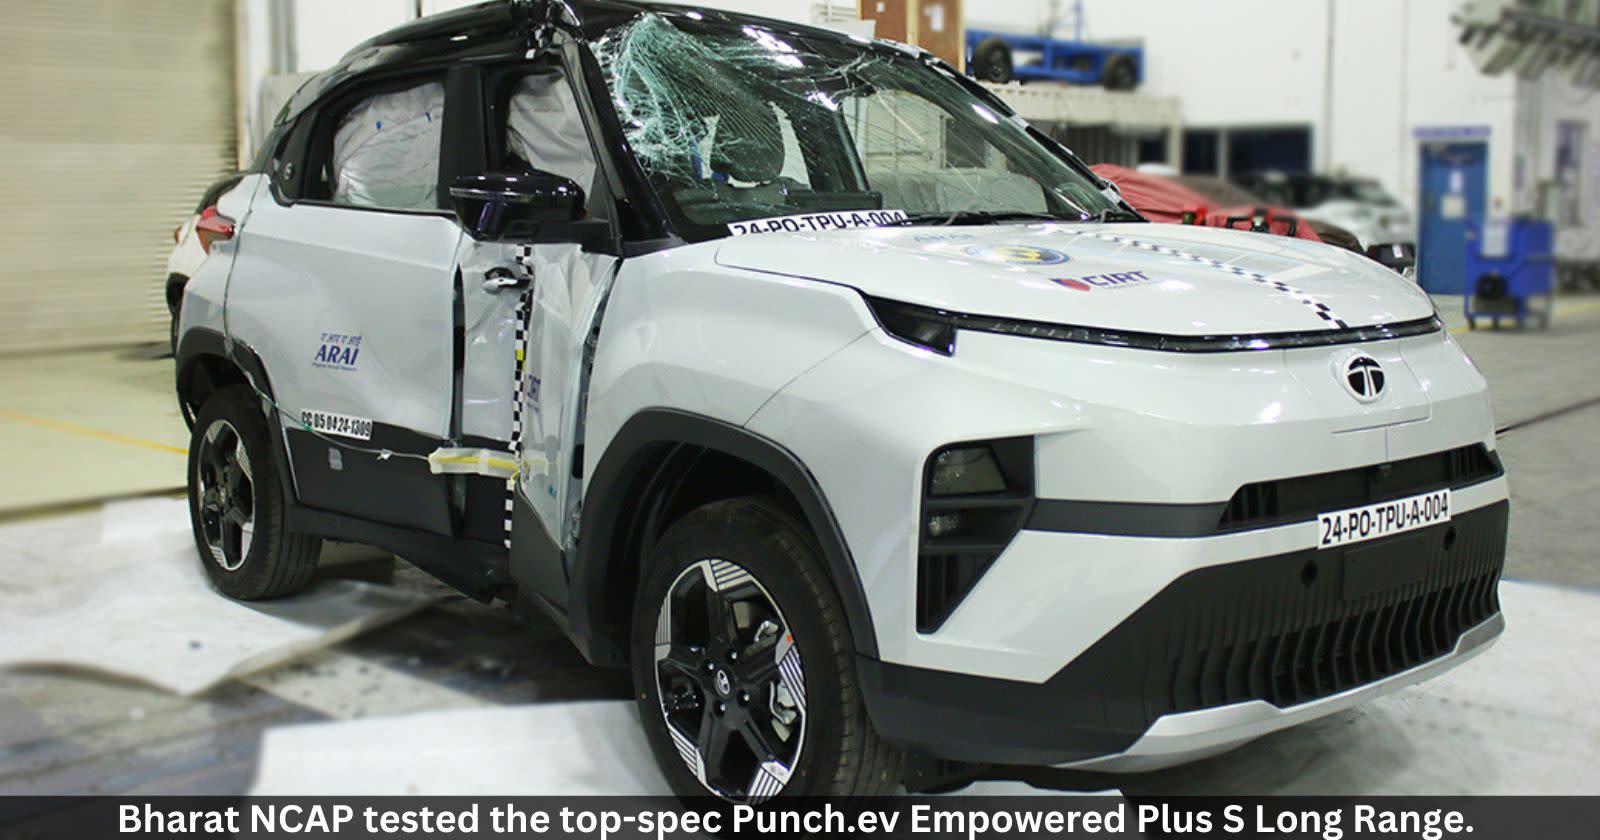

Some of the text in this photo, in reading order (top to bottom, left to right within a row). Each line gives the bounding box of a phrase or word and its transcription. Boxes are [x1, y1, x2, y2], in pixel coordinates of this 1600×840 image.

[1081, 270, 1150, 286] CIRT
[314, 344, 359, 365] ARAI
[1322, 492, 1448, 544] 24-PO-TPU-A-004
